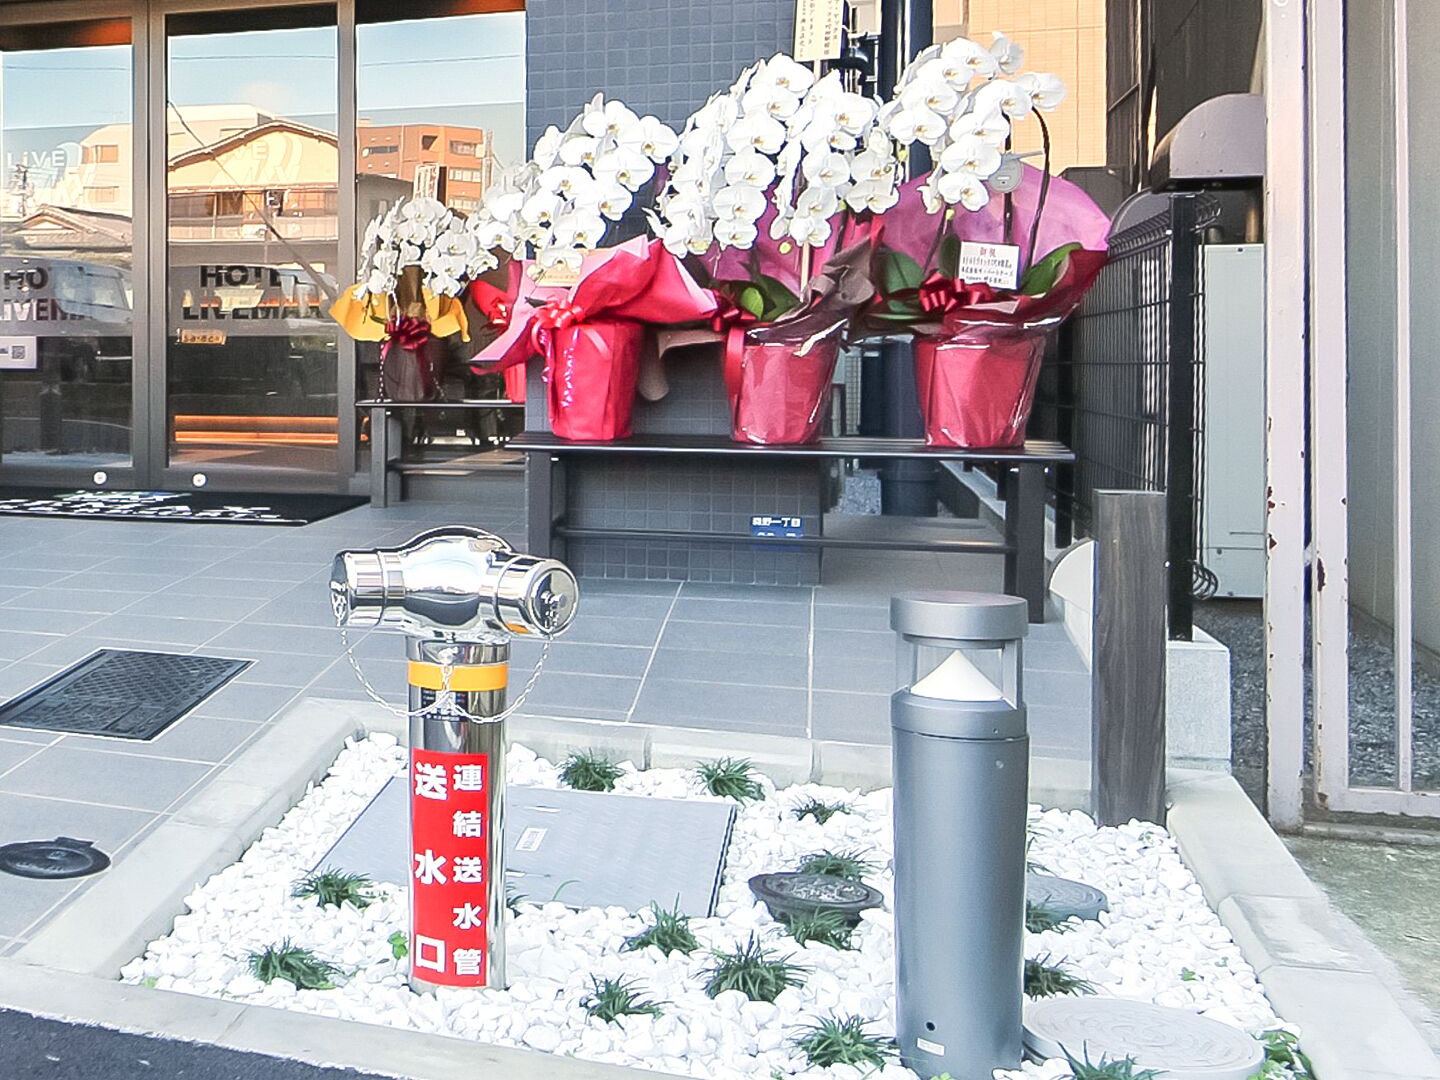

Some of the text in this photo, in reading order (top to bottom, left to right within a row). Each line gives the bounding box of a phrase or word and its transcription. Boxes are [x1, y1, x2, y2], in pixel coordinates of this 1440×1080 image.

[414, 760, 448, 974] 送水口
[452, 763, 484, 977] 連結送水管
